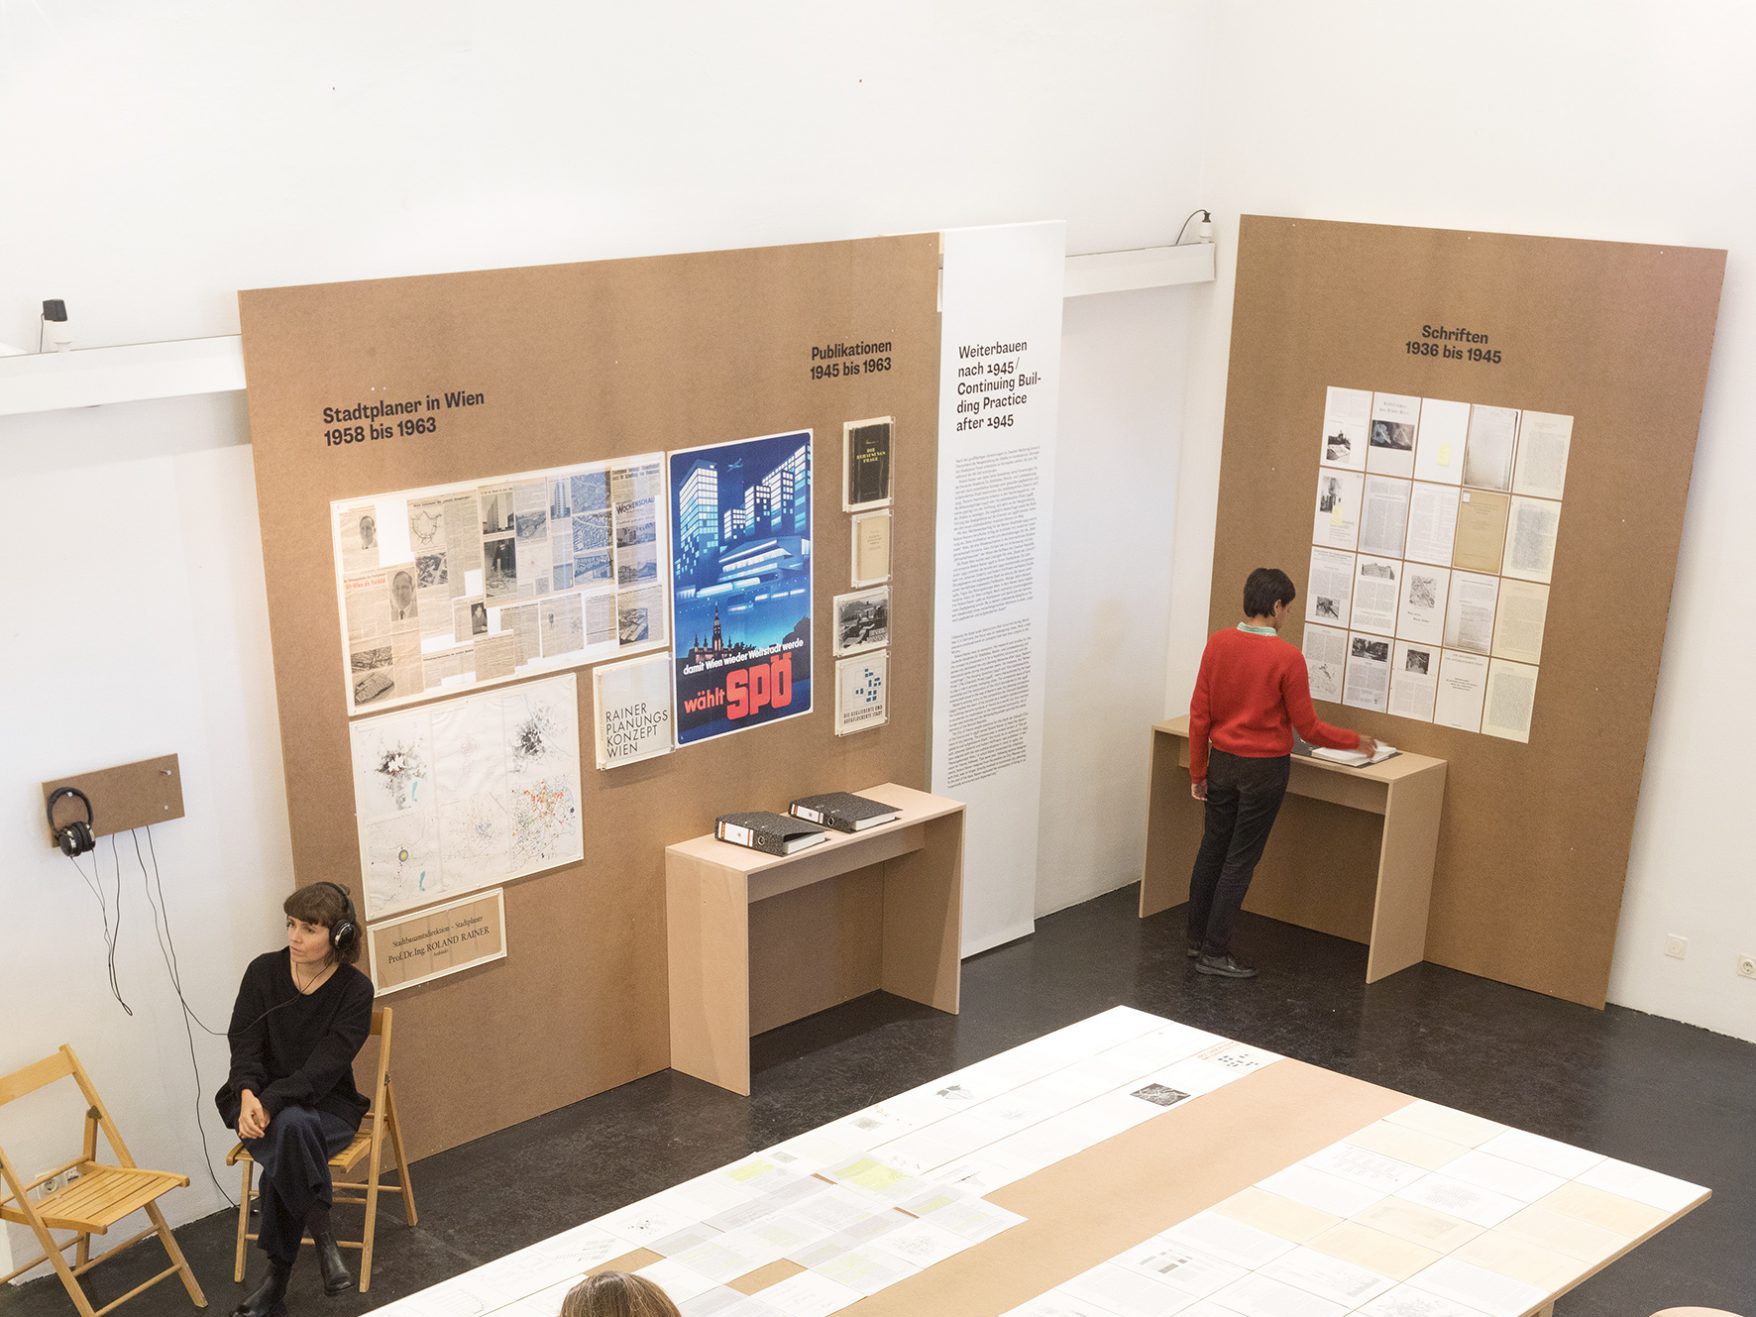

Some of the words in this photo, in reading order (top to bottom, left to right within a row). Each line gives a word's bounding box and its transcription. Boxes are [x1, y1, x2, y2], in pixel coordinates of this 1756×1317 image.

[1421, 324, 1489, 344] Schriften
[811, 341, 892, 361] Publikationen
[959, 341, 1028, 359] Weiterbauen
[1405, 340, 1439, 357] 1936
[1443, 344, 1463, 360] bis
[1467, 347, 1502, 364] 1945
[810, 363, 840, 380] 1945
[842, 361, 860, 376] bis
[863, 357, 892, 374] 1963
[958, 361, 984, 378] nach
[957, 377, 1015, 395] Continuing
[1018, 371, 1041, 387] Buil-
[323, 400, 422, 424] Stadtplaner
[426, 394, 440, 411] in
[444, 390, 485, 409] Wien
[957, 399, 980, 415] ding
[983, 393, 1027, 410] Practice
[324, 426, 365, 447] 1958
[370, 423, 394, 441] bis
[397, 416, 437, 437] 1963
[956, 417, 984, 432] after
[987, 414, 1014, 429] 1945
[683, 662, 705, 675] damit
[705, 657, 723, 669] Wien
[723, 652, 747, 665] wieder
[748, 644, 782, 660] Weltstadt
[782, 638, 804, 651] werde
[683, 687, 725, 714] wählt
[726, 651, 792, 720] SPÖ
[606, 702, 647, 723] RAINER
[606, 709, 668, 735] PLANUNGS
[606, 724, 658, 747] KONZEPT
[607, 742, 638, 758] WIEN
[426, 936, 459, 952] ROLAND
[461, 926, 489, 941] RAINER
